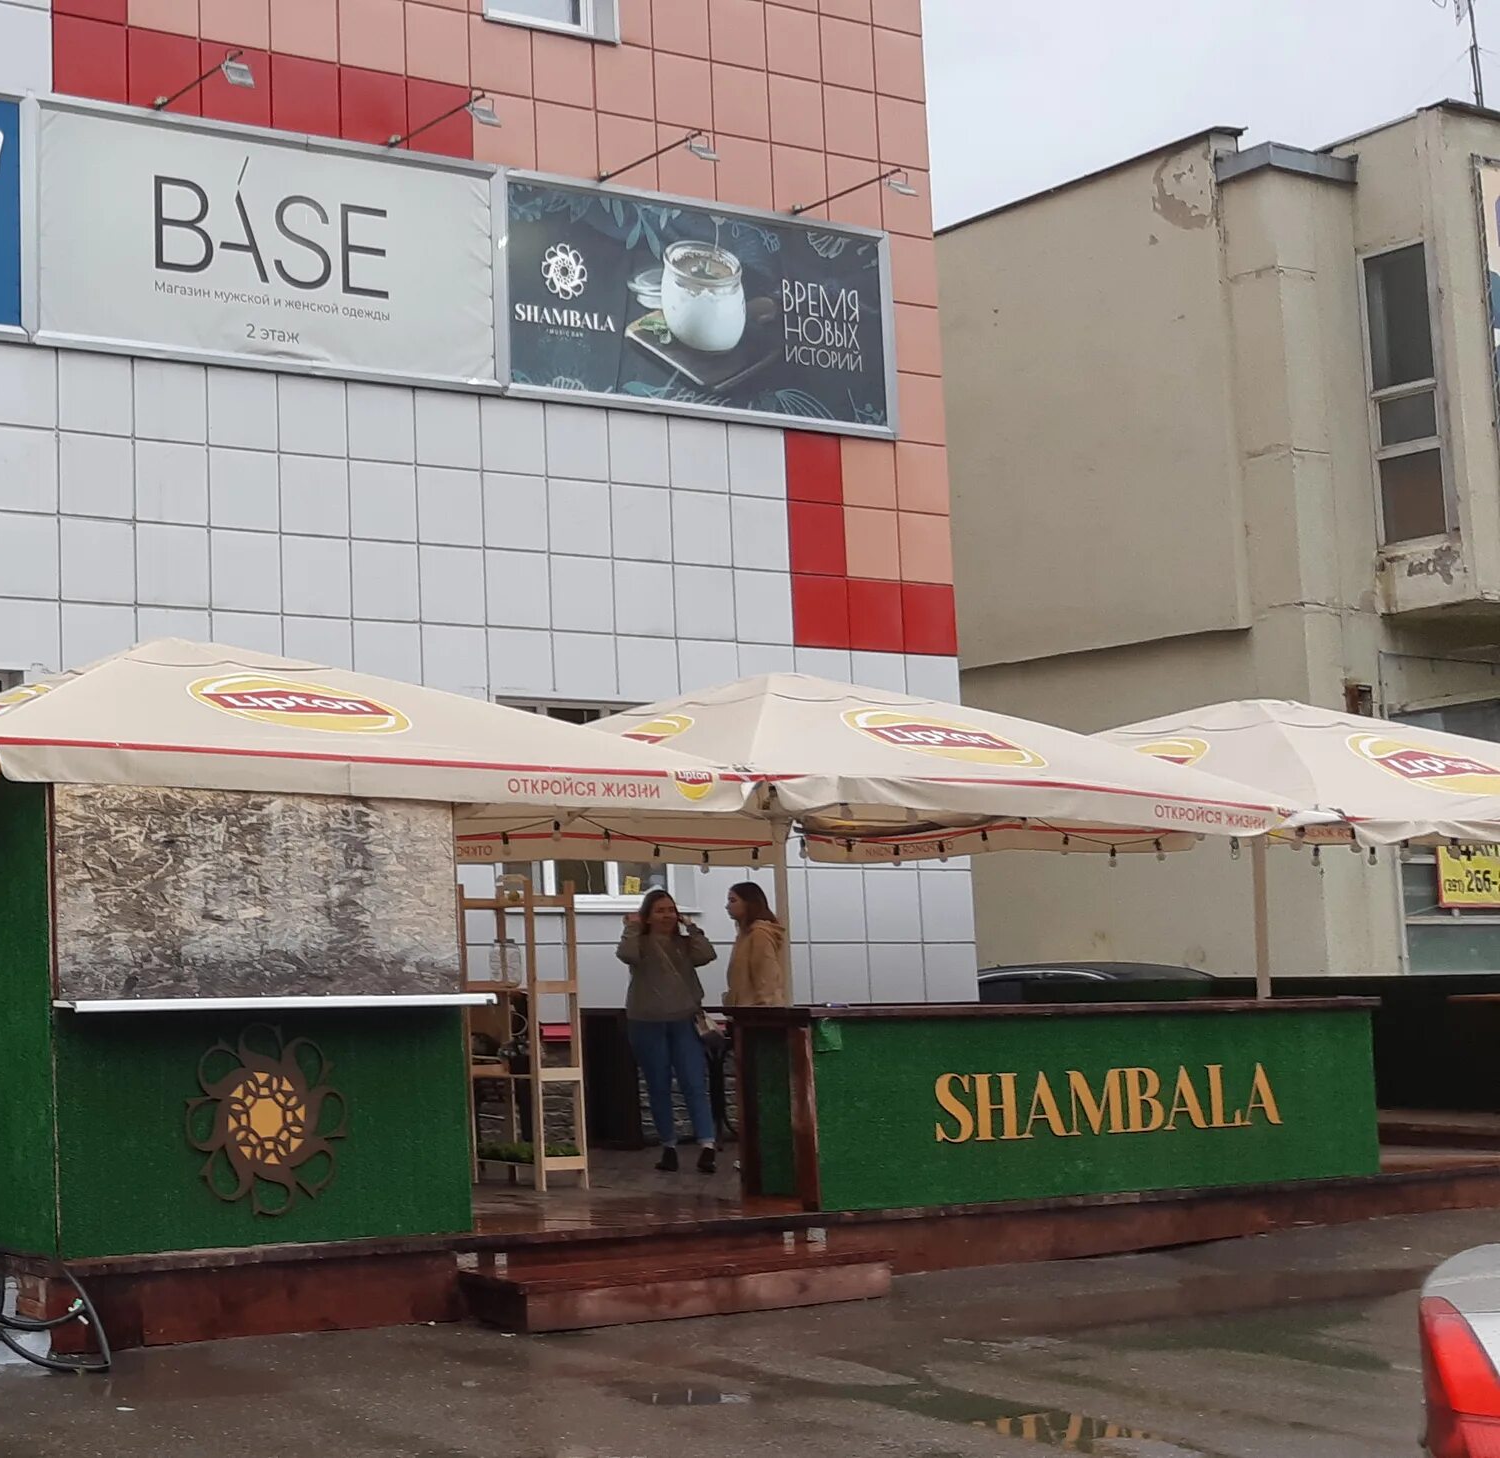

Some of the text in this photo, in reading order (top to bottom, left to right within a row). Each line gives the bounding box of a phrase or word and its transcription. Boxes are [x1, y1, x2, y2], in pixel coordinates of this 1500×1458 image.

[153, 279, 391, 322] Магазин мужской и женской одежды
[782, 278, 859, 322] ВРЕМЯ
[514, 303, 616, 332] SHAMBALA
[245, 322, 300, 344] 2 этаж
[784, 313, 860, 350] НОВЫХ
[785, 344, 862, 372] ИСТОРИЙ
[220, 694, 373, 710] Lipton
[877, 728, 1003, 747] Lipton
[508, 777, 661, 799] ОТКРОЙСЯ ЖИЗНИ
[678, 769, 710, 782] Lipton
[1154, 804, 1266, 829] ОТКРОЙСЯ ЖИЗНИ
[934, 1062, 1284, 1143] SHAMBALA
